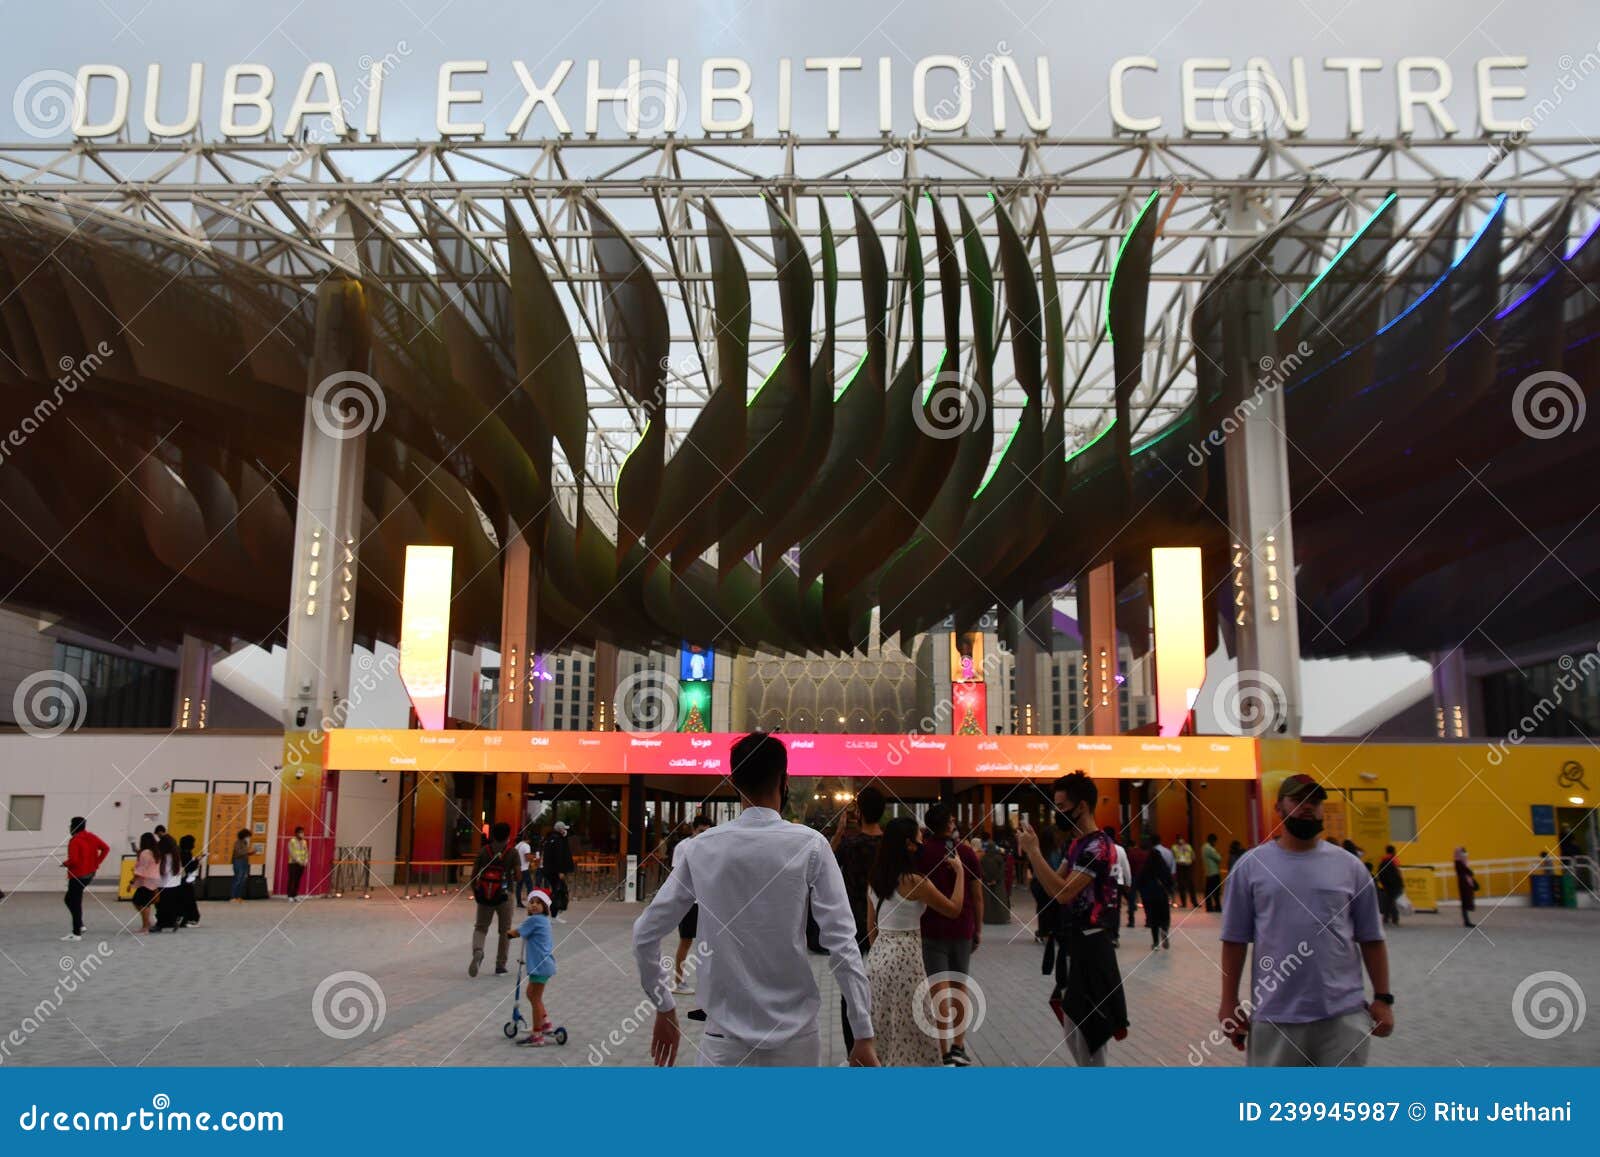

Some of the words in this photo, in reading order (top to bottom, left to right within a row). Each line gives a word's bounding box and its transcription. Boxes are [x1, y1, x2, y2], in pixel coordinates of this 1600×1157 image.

[72, 61, 384, 137] DUBAI
[436, 54, 1052, 135] EXHIBITION
[1109, 56, 1529, 134] CENTRE
